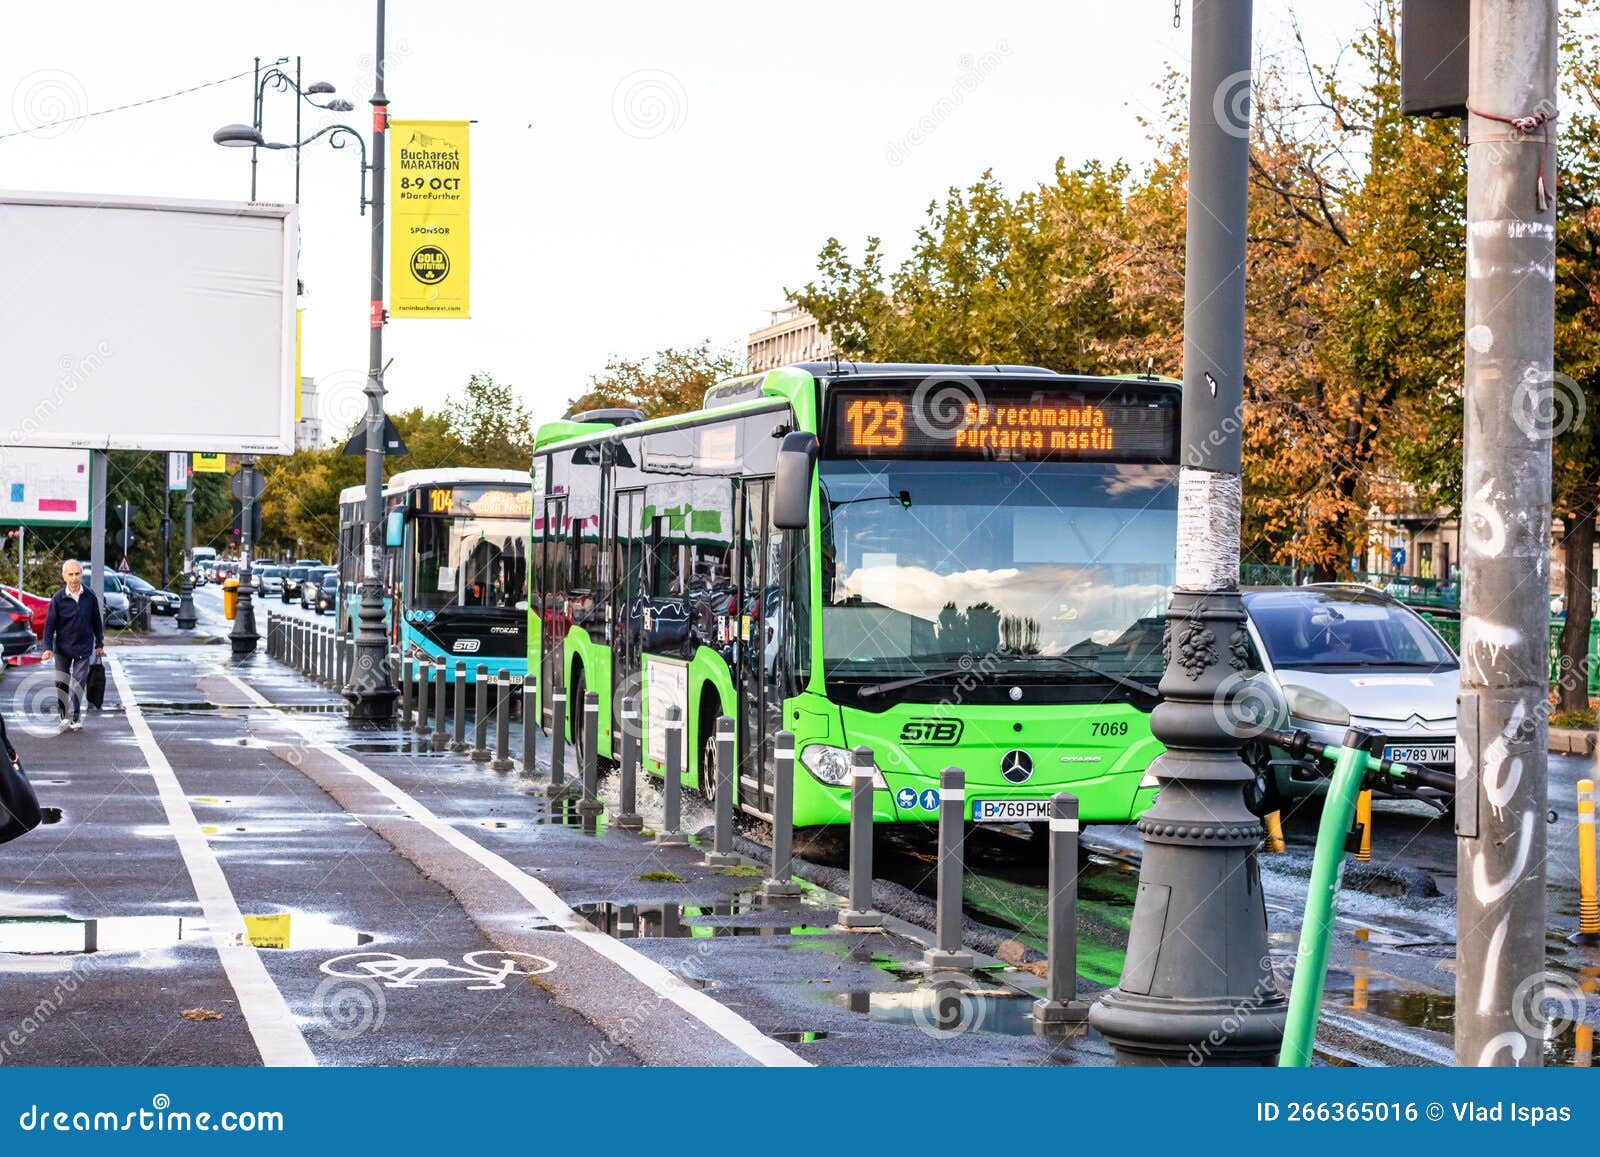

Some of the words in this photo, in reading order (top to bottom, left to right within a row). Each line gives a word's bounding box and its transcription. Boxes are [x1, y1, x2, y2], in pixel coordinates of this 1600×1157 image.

[400, 149, 459, 160] Bucharest
[400, 160, 460, 170] MARATHON
[401, 178, 425, 189] 8-9
[429, 178, 461, 190] OCT
[400, 192, 460, 200] #DareFurther
[417, 253, 443, 263] GOLD
[965, 403, 989, 425] Se
[997, 406, 1103, 427] recomanda
[847, 400, 904, 446] 123
[1050, 428, 1113, 449] mastii
[431, 490, 453, 512] 104
[453, 641, 478, 650] STB
[900, 721, 959, 743] STB
[1091, 722, 1128, 736] 7069
